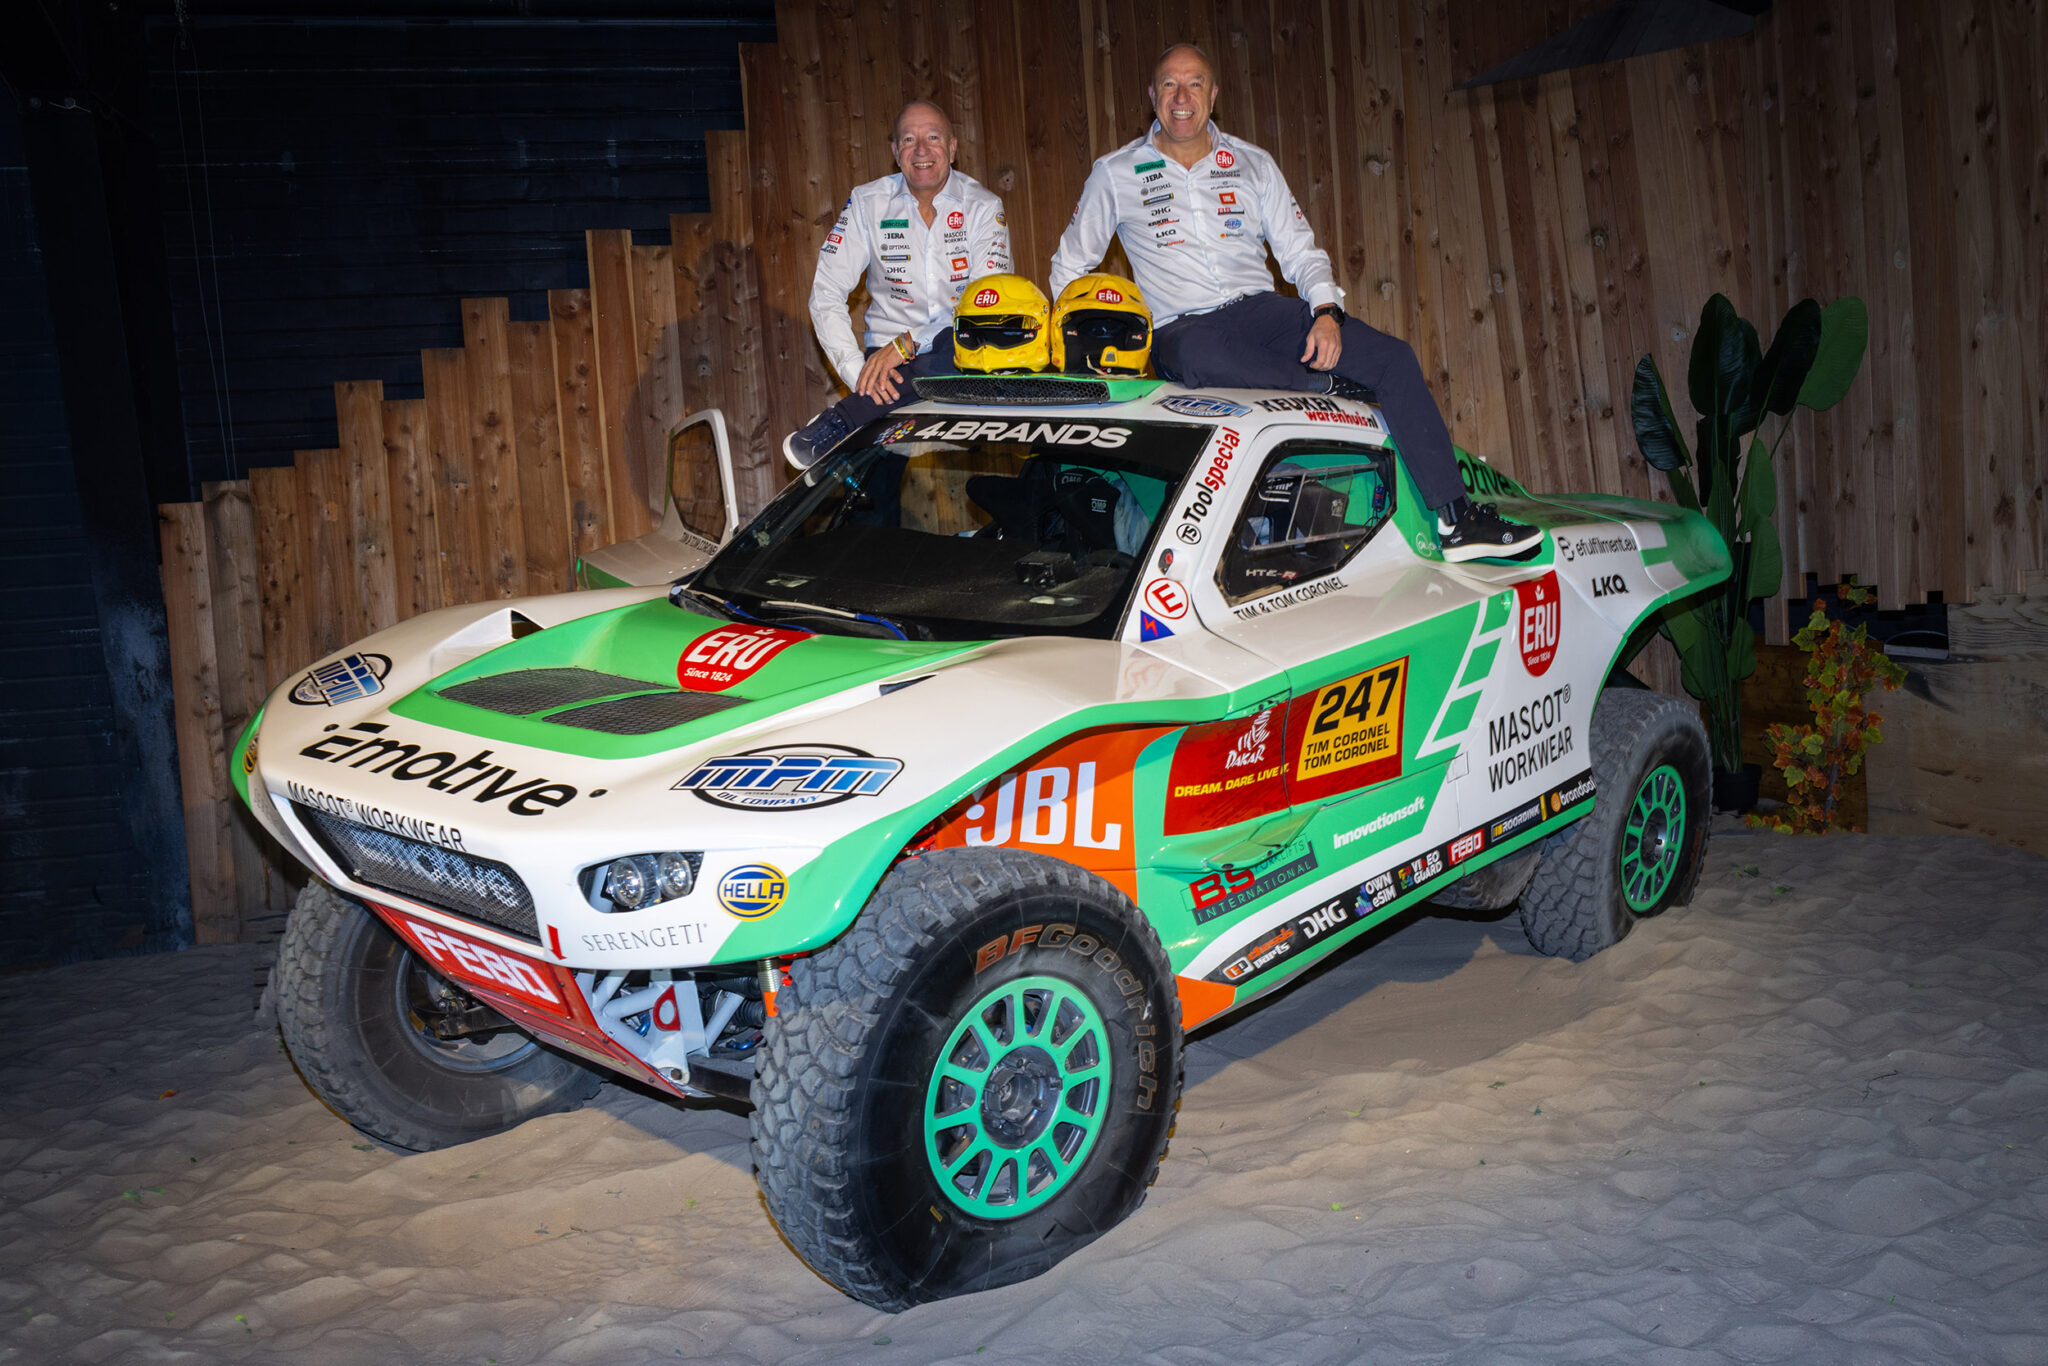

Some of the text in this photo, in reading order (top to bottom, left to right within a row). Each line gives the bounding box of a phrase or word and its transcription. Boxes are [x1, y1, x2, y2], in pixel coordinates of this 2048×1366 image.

[1217, 153, 1233, 165] ERU
[976, 294, 998, 304] ERU
[1098, 292, 1120, 302] ERU
[1254, 397, 1341, 412] KEUKEN
[1458, 454, 1518, 497] otive
[1151, 583, 1184, 614] E
[1233, 576, 1348, 621] TIM & TOM CORONEL
[1592, 574, 1629, 598] LKQ
[1523, 600, 1557, 654] ERU
[685, 631, 787, 670] ERU
[684, 667, 733, 683] Since 1824
[1312, 666, 1400, 735] 247
[1304, 737, 1389, 771] TOM CORONEL
[1307, 722, 1390, 756] TIM CORONEL
[1488, 726, 1574, 792] WORKWEAR
[716, 791, 820, 806] OIL COMPANY
[1174, 782, 1223, 798] DREAM.
[1256, 766, 1280, 782] LIVE
[965, 761, 1122, 850] JBL
[1502, 803, 1540, 834] ROORDINK
[355, 803, 467, 851] WORKWEAR
[1333, 796, 1425, 849] Innovationsoft
[1450, 832, 1482, 863] FEBO
[724, 882, 785, 900] HELLA
[1189, 869, 1255, 910] BS
[1197, 860, 1312, 922] INTERNATIONAL
[1365, 871, 1393, 895] OWN
[1372, 885, 1397, 908] eSIM
[1298, 900, 1349, 939] DHG
[405, 920, 560, 1004] FEBO
[1253, 942, 1291, 969] parts
